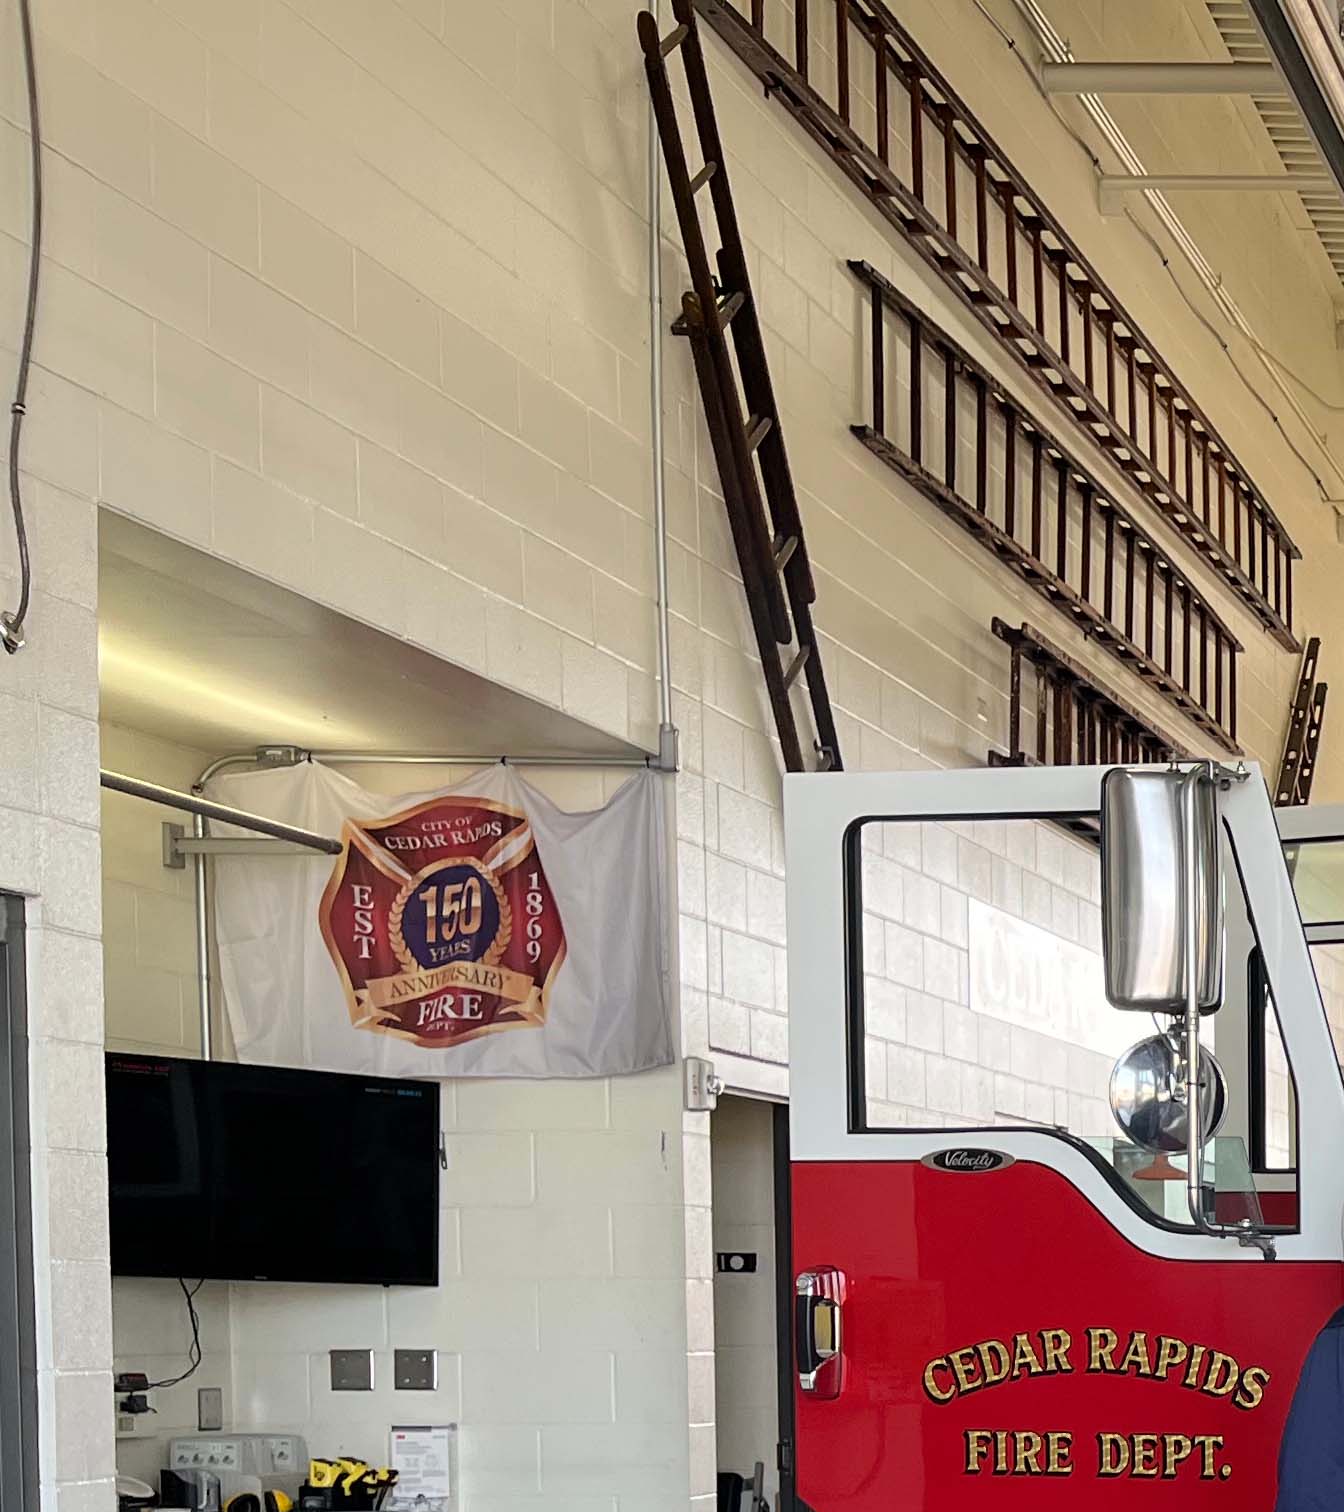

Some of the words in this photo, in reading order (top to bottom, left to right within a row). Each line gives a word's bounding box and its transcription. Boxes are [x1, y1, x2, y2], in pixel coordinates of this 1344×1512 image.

[384, 830, 449, 850] CEDAR
[421, 820, 452, 832] CITY
[455, 816, 473, 827] OF
[352, 884, 376, 959] EST
[418, 877, 483, 944] 150
[525, 872, 543, 963] 1869
[428, 938, 471, 962] YEARS
[389, 966, 506, 998] ANNIVERSARY
[416, 993, 484, 1026] FIRE
[944, 1151, 994, 1170] Velocity
[922, 1328, 1073, 1405] CEDAR
[1085, 1327, 1271, 1411] RAPIDS
[963, 1429, 1073, 1476] FIRE
[1096, 1431, 1233, 1480] DEPT.
